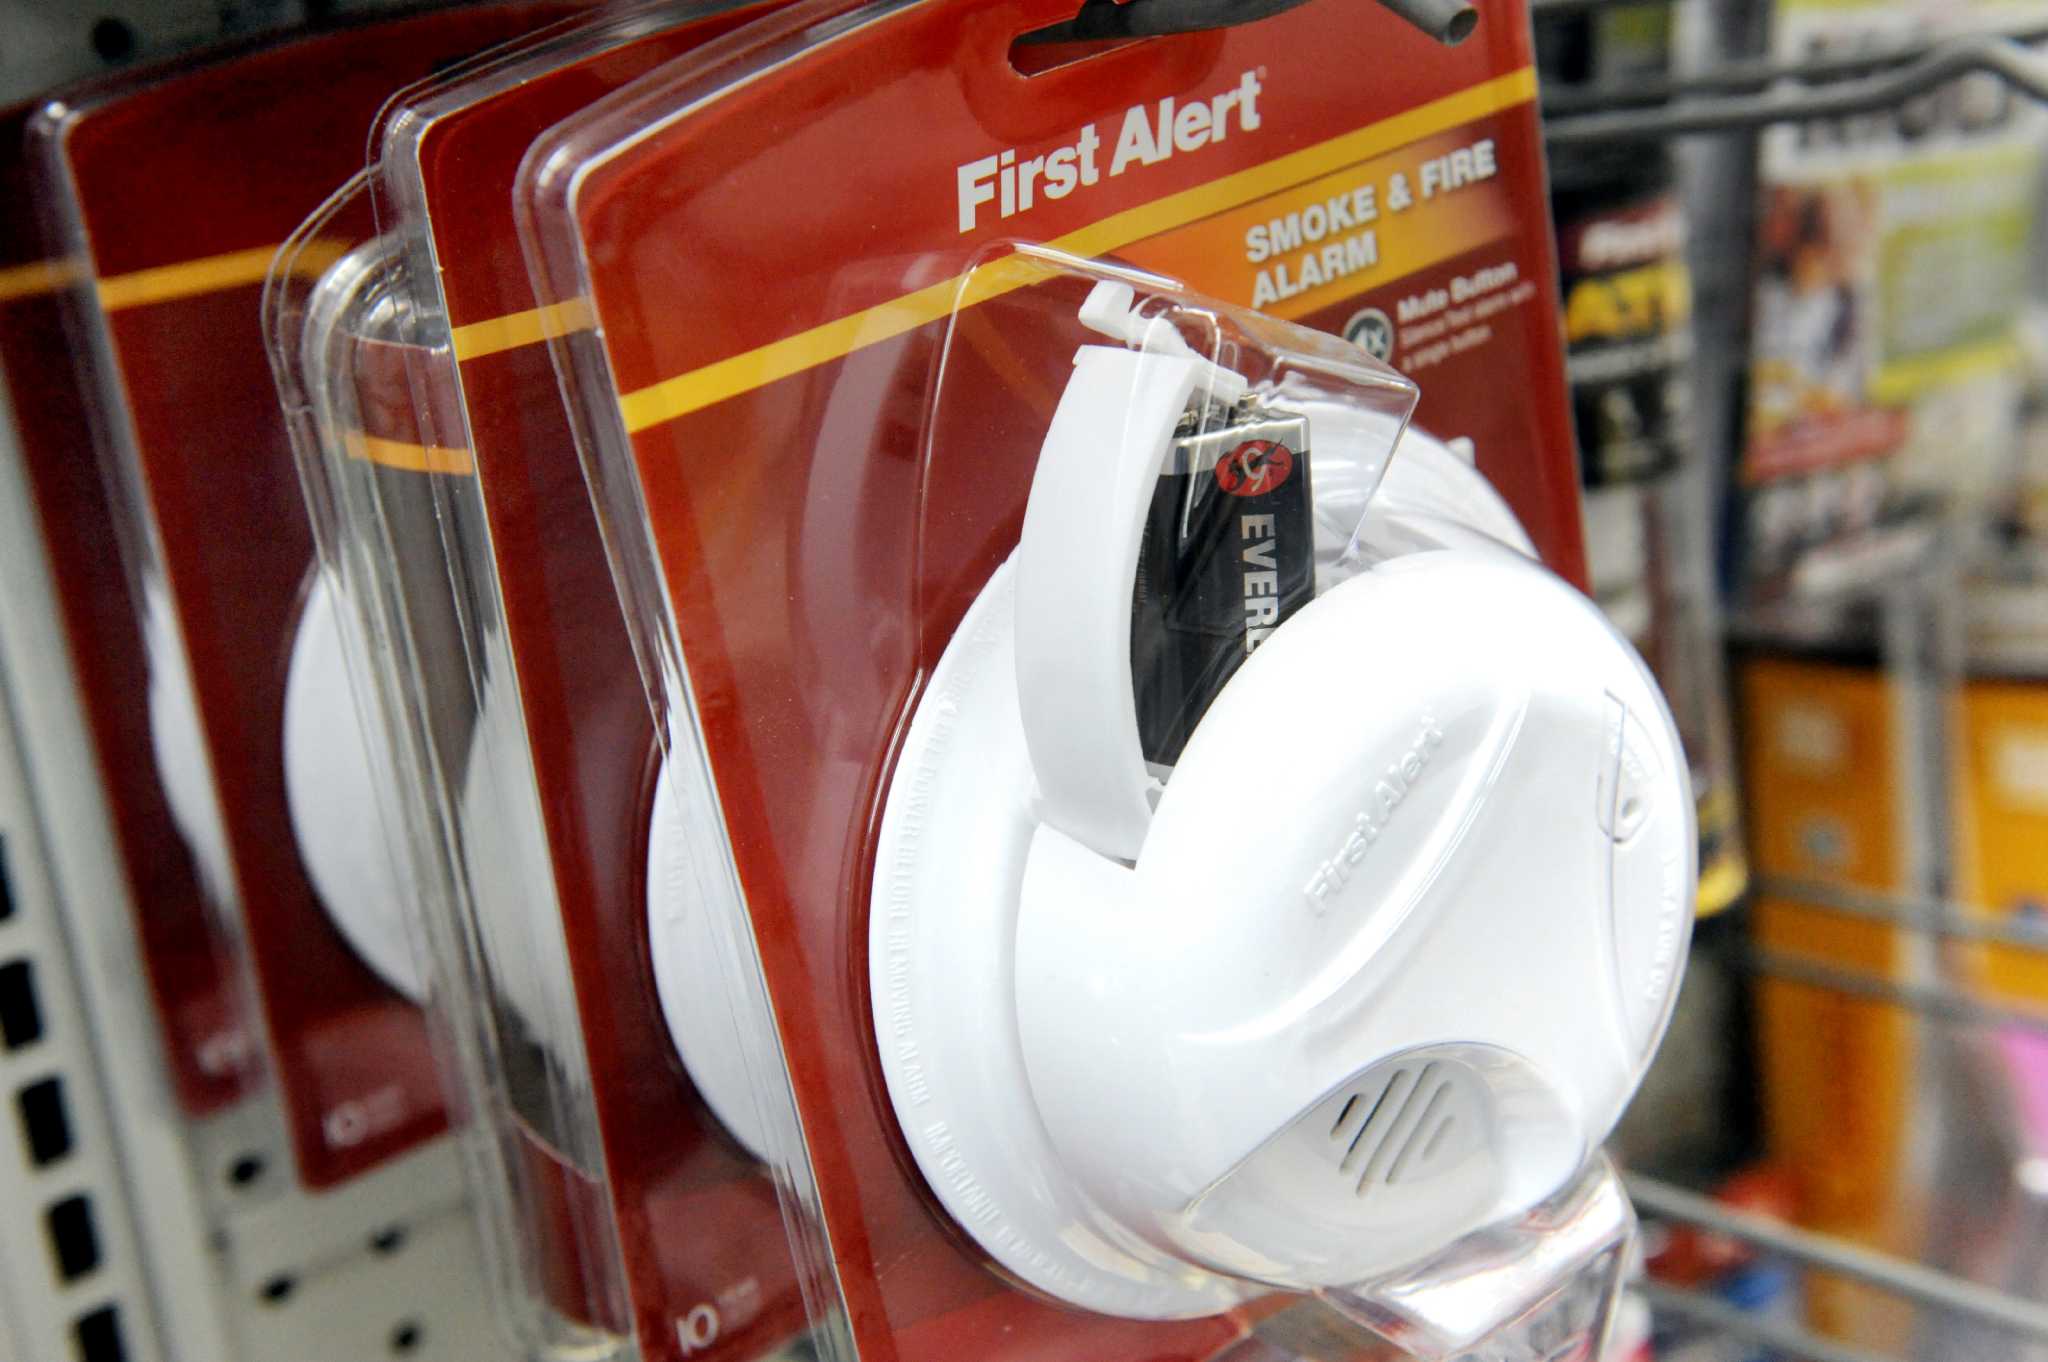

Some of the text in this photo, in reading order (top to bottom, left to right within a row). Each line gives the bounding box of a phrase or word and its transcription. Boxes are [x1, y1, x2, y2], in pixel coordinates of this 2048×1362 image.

[957, 70, 1261, 233] First Alert
[1246, 139, 1497, 263] SMOKE & FIRE
[1252, 231, 1378, 310] ALARM
[1398, 261, 1519, 322] Mute Button
[1303, 704, 1444, 918] First Alert
